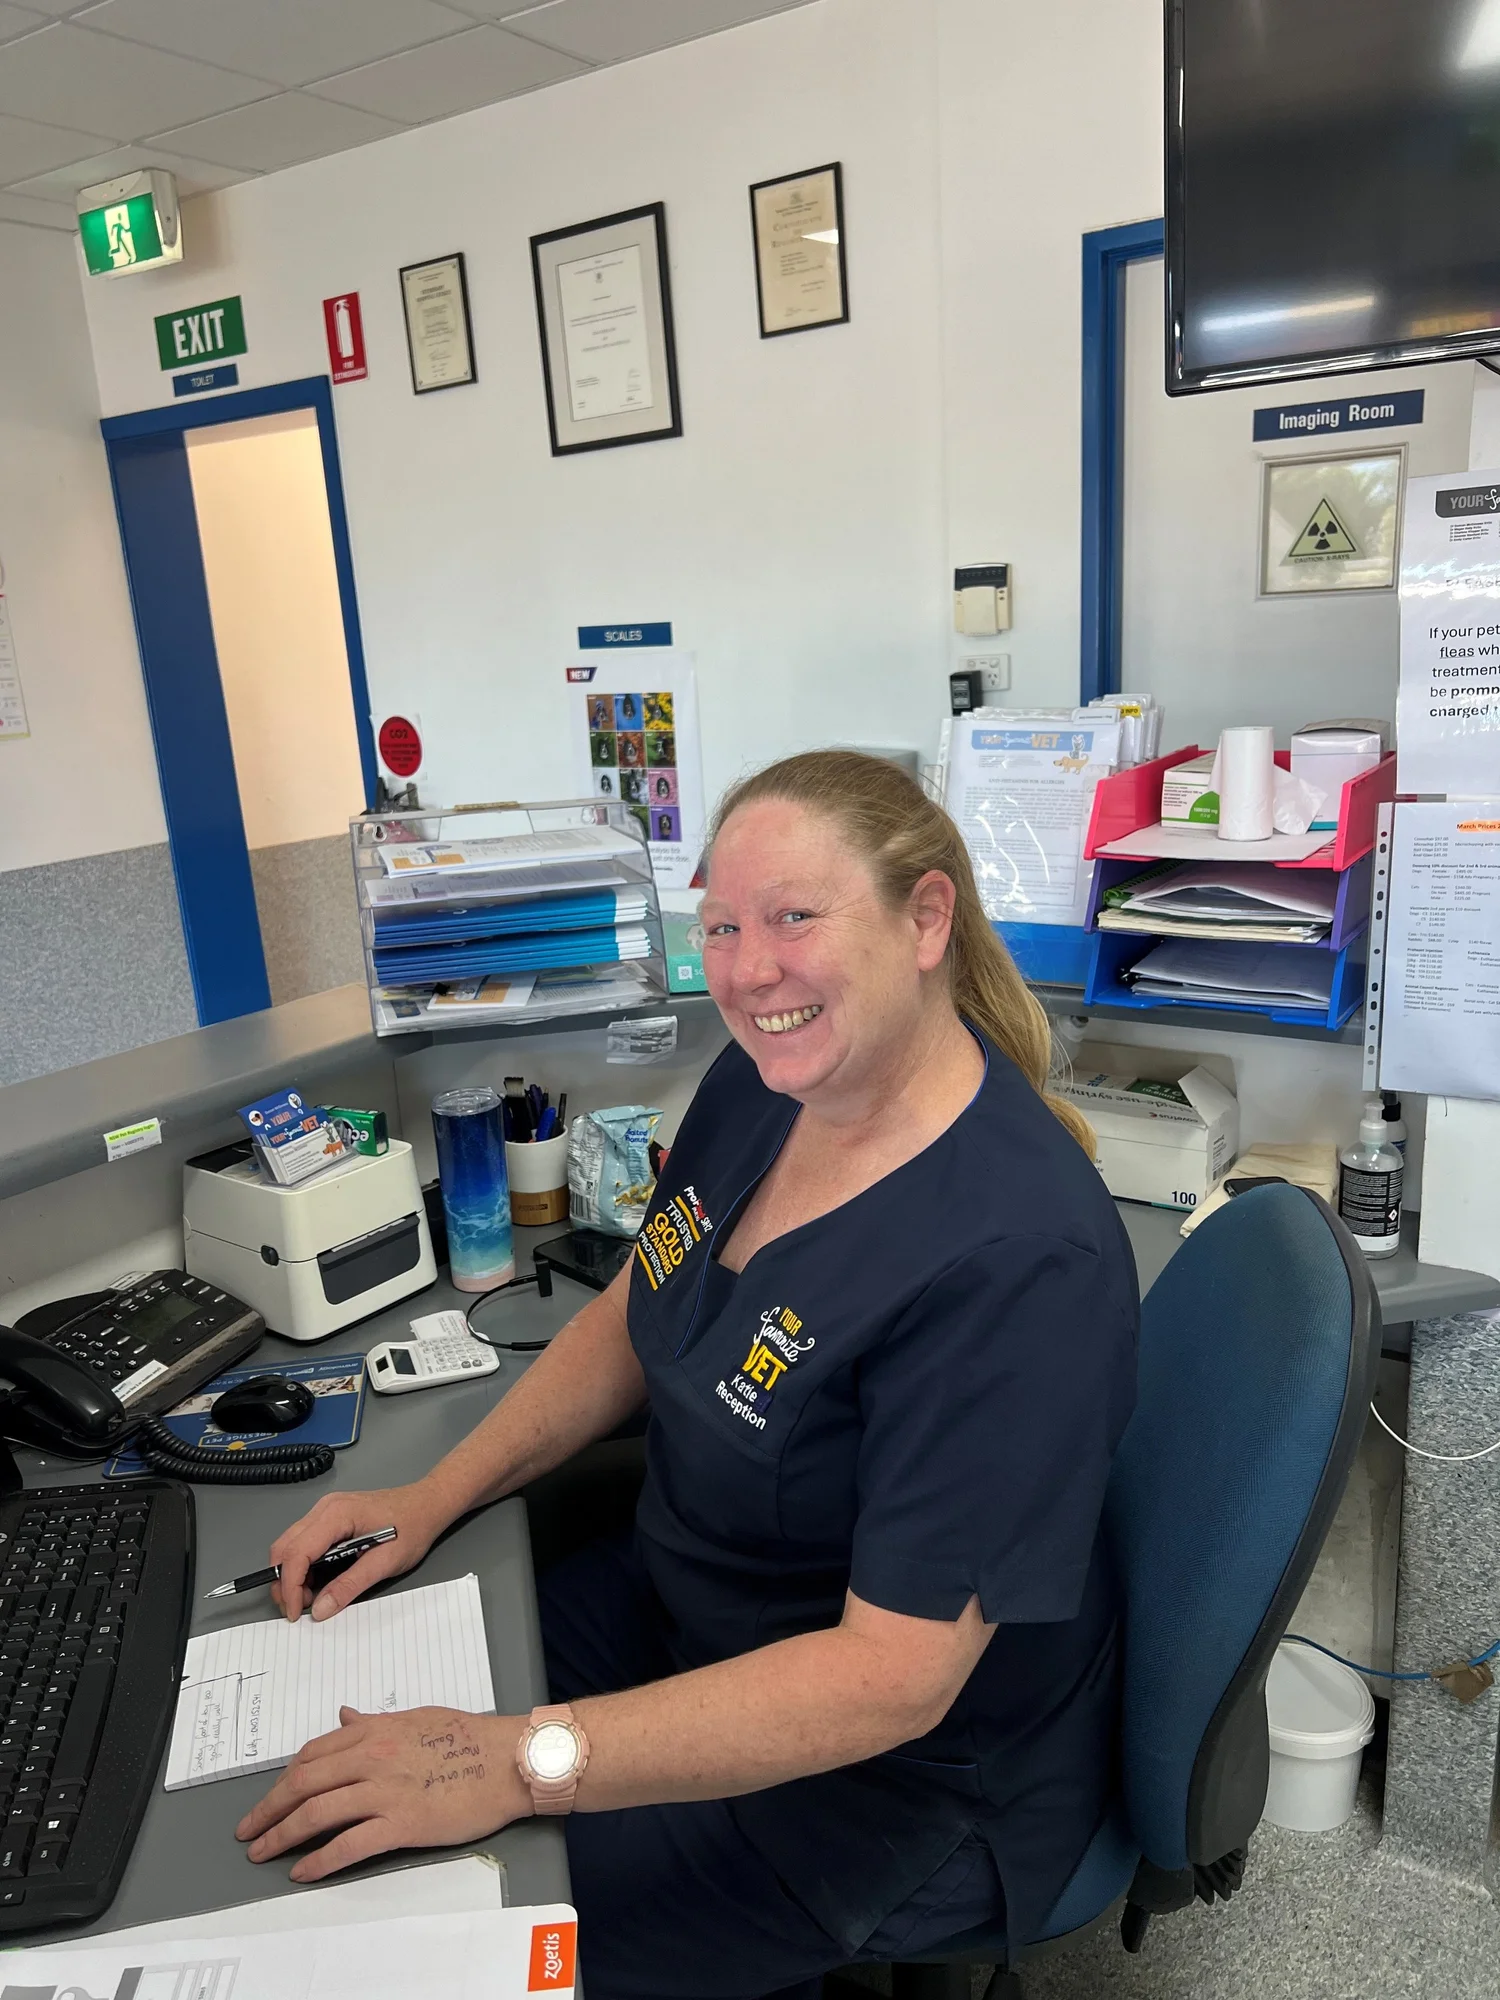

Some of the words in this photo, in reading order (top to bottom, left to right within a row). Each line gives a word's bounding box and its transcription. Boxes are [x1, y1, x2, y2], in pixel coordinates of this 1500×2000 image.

[172, 308, 224, 359] EXIT
[190, 374, 214, 387] TOILET
[1279, 409, 1340, 430] Imaging
[1349, 404, 1394, 422] Room
[1450, 495, 1484, 509] YOUR
[604, 630, 642, 642] SCALES
[1430, 627, 1438, 639] If
[1441, 628, 1473, 640] your
[1439, 647, 1474, 659] fleas
[570, 670, 590, 680] NEW
[1430, 687, 1447, 698] be
[1031, 733, 1060, 748] VET
[270, 1111, 292, 1126] YOUR
[302, 1115, 319, 1132] VET
[1159, 1113, 1198, 1123] covetrus
[1172, 1191, 1196, 1205] 100
[666, 1200, 694, 1251] TRUSTED
[654, 1212, 684, 1266] GOLD
[646, 1223, 673, 1275] STANDARD
[639, 1231, 666, 1284] PROTECTION
[779, 1307, 802, 1336] YOUR
[742, 1342, 788, 1391] VET
[731, 1374, 758, 1402] Katie
[715, 1380, 767, 1430] Reception
[448, 1770, 458, 1780] on
[542, 1933, 563, 1980] zoetis
